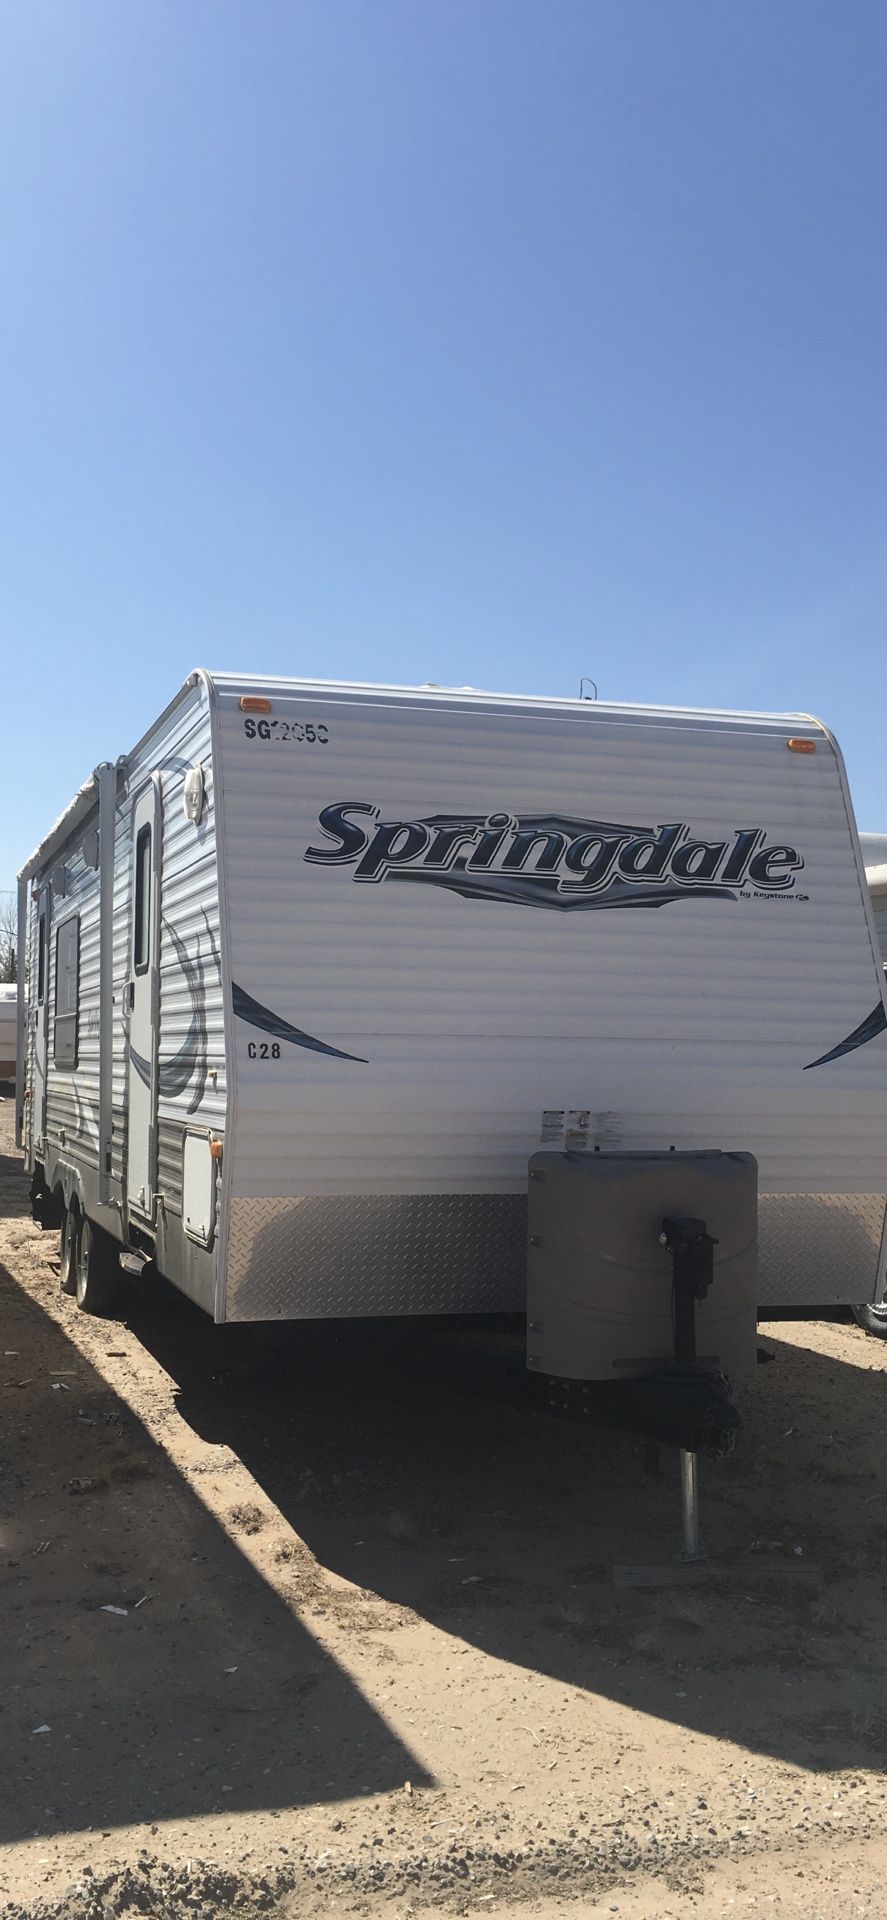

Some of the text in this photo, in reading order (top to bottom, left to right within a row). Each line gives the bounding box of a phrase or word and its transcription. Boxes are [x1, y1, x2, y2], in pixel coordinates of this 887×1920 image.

[244, 719, 329, 744] SG25
[303, 801, 805, 895] Springdale
[740, 890, 794, 900] by Keystone
[248, 1042, 281, 1059] C28
